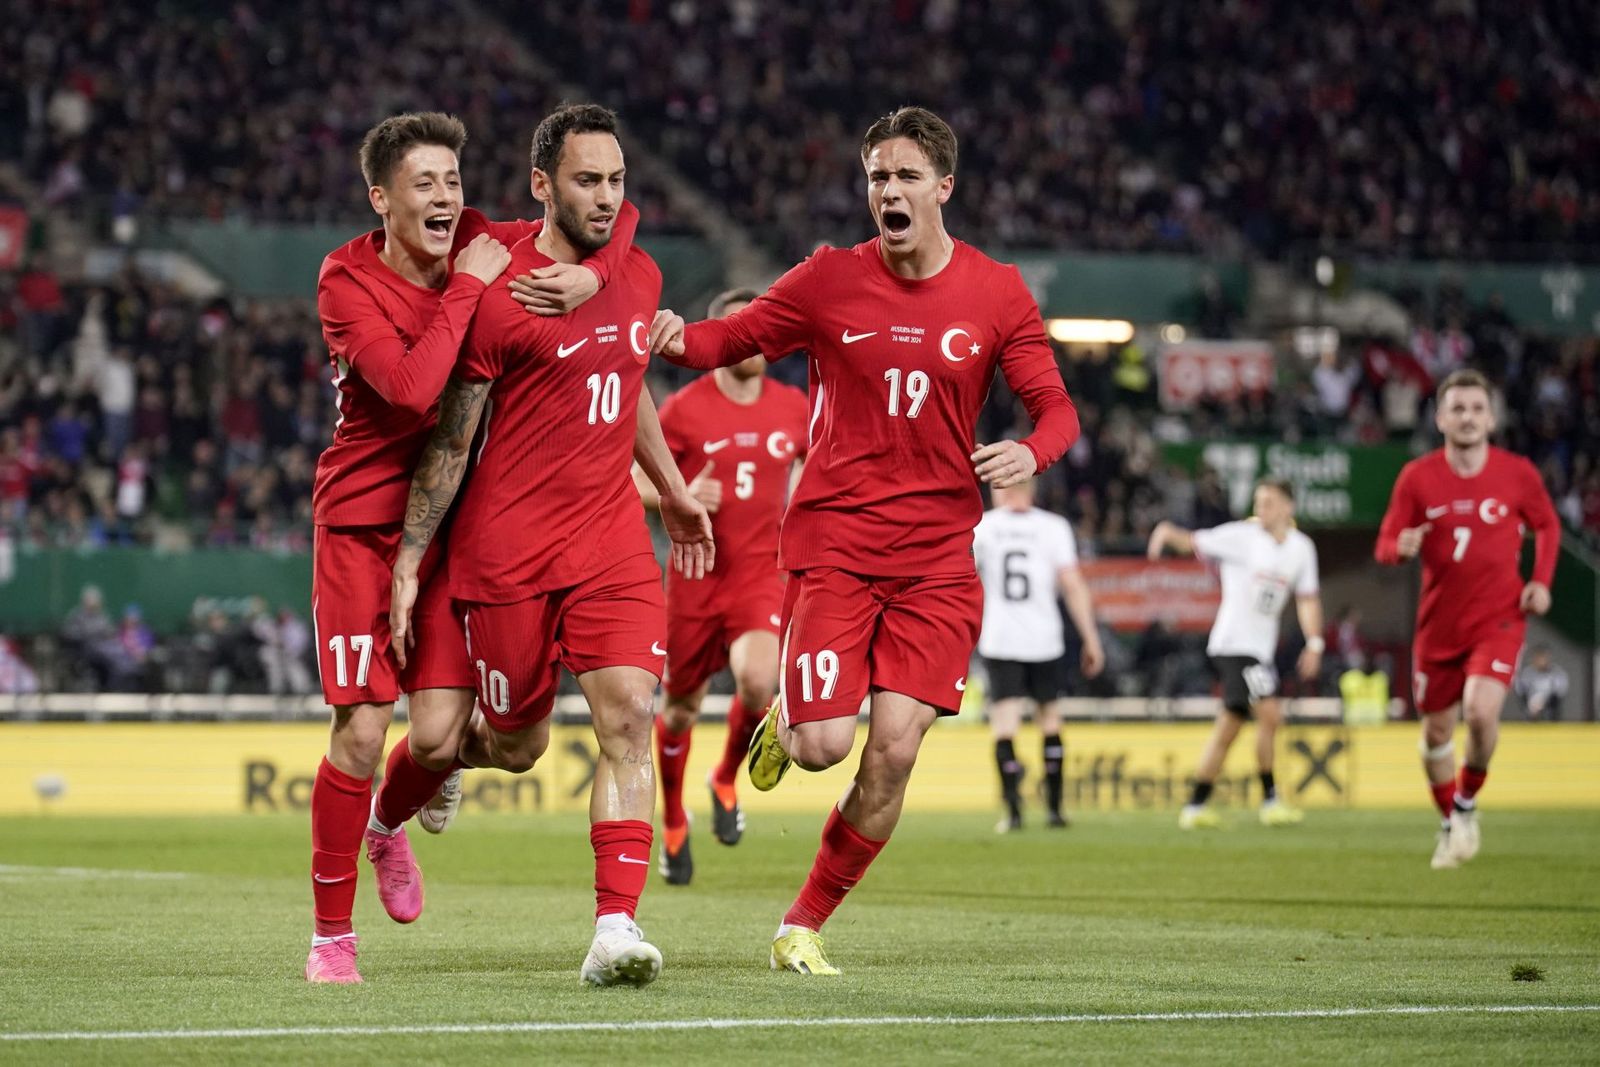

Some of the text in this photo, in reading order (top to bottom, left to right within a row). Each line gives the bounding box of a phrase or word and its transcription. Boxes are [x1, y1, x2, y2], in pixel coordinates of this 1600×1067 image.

[586, 371, 621, 425] 10
[884, 367, 930, 419] 19
[735, 460, 757, 500] 5
[1452, 525, 1473, 563] 7
[1002, 549, 1031, 602] 6
[328, 634, 374, 687] 17
[476, 659, 510, 715] 10
[796, 649, 840, 703] 19
